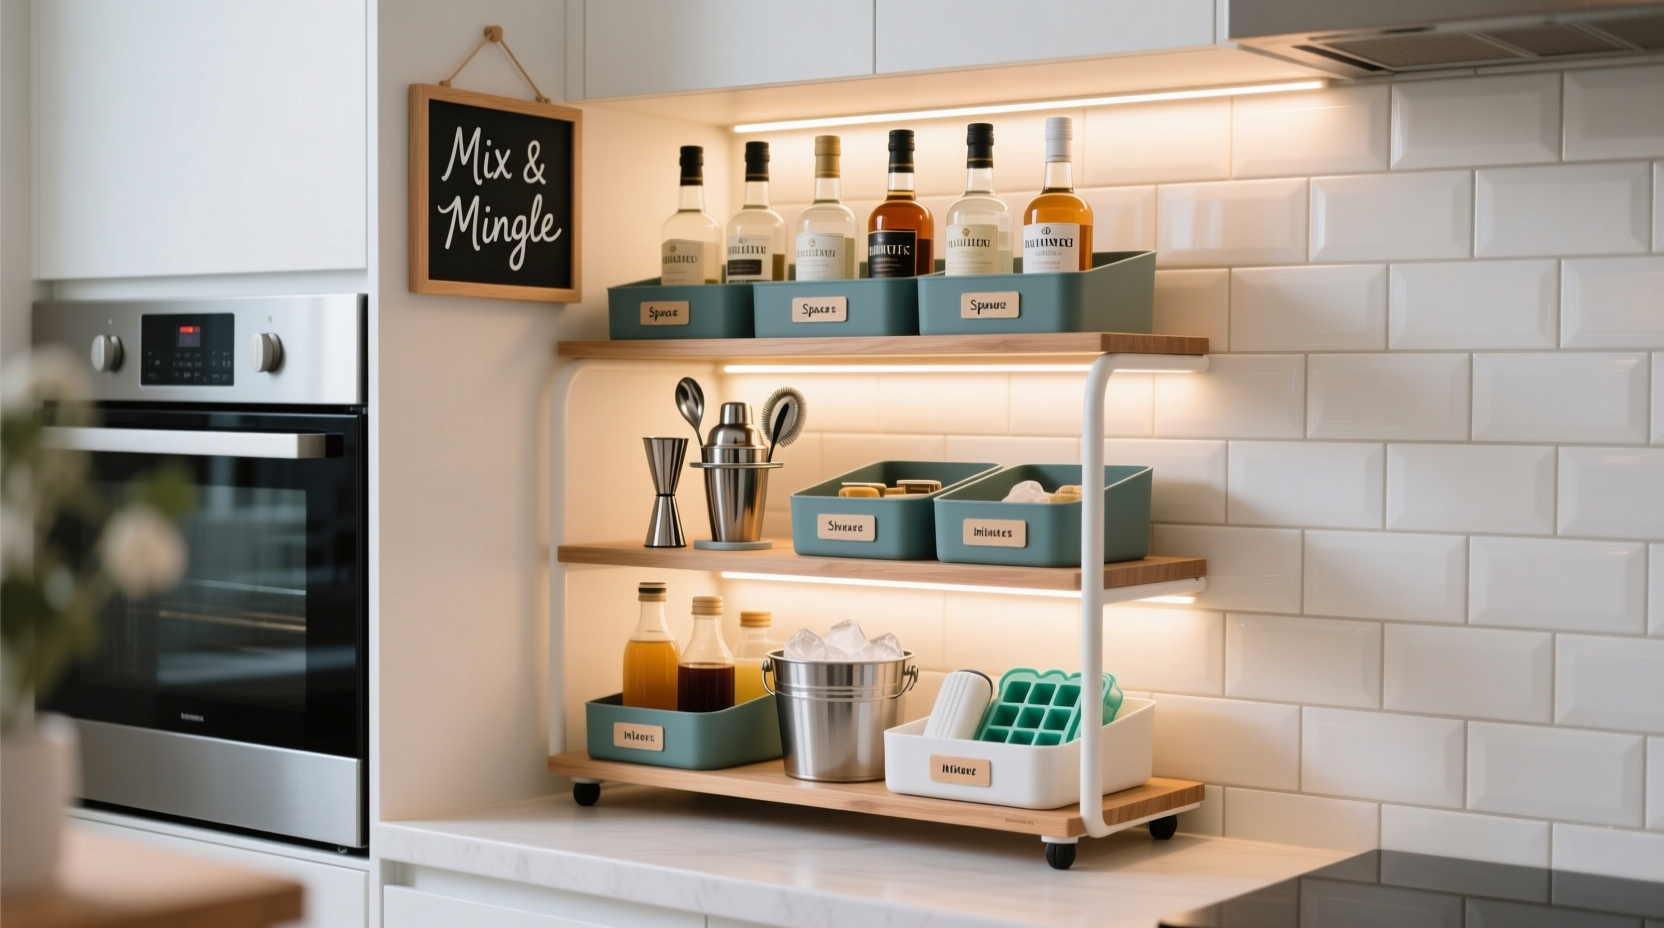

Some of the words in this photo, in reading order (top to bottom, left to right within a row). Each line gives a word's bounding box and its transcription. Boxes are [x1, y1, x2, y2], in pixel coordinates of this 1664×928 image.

[441, 126, 512, 186] Mix
[523, 140, 546, 185] &
[437, 193, 562, 271] Mingle
